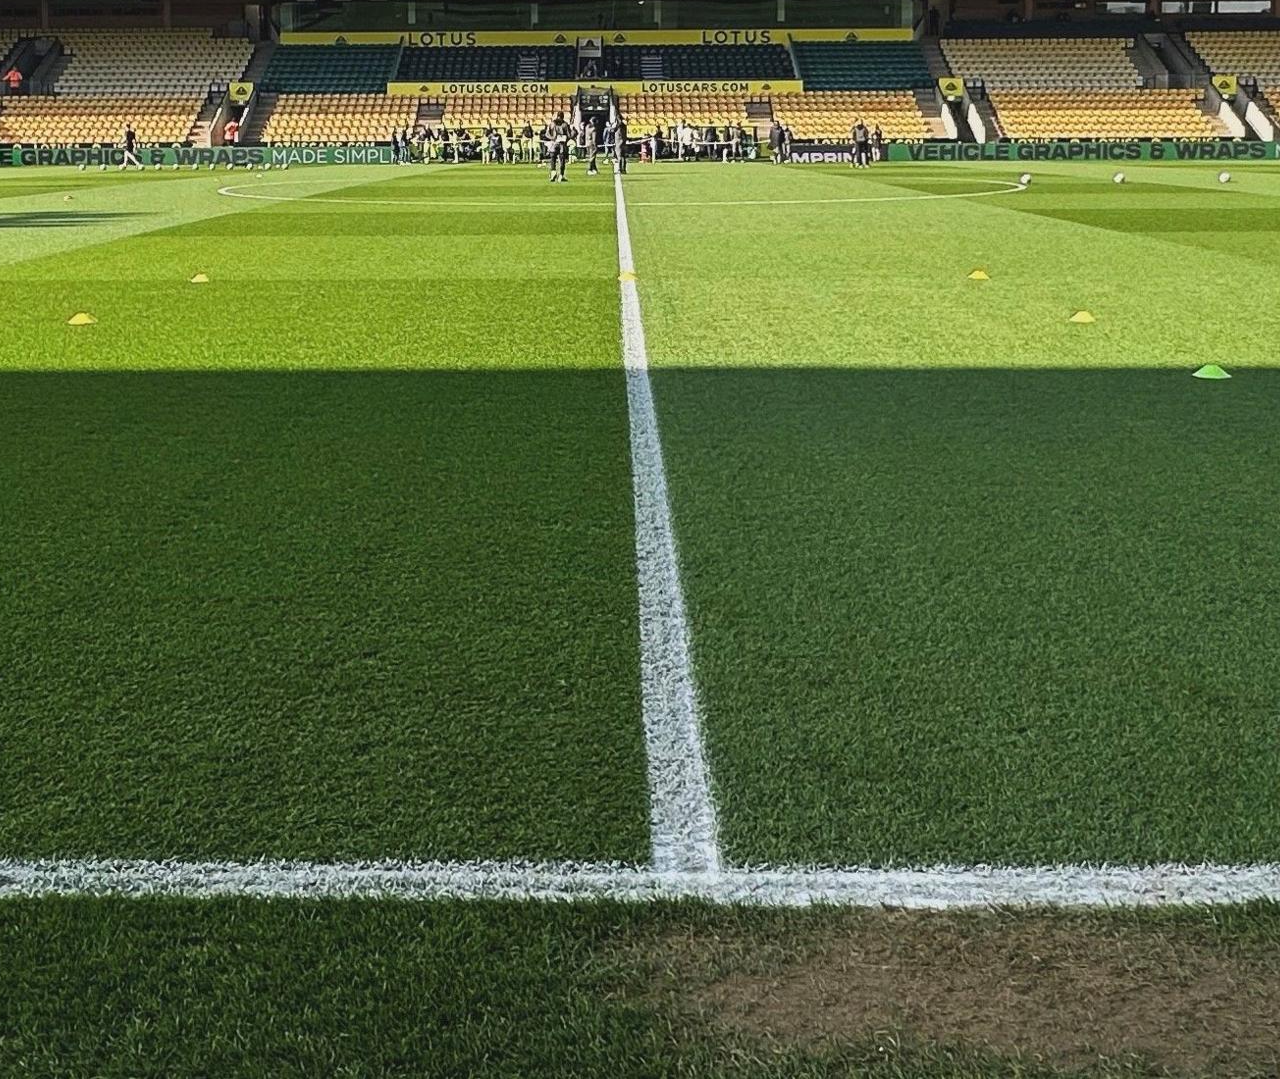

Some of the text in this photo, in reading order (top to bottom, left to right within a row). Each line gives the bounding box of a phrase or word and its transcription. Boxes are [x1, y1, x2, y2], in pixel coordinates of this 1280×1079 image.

[408, 32, 477, 46] LOTUS
[702, 31, 771, 45] LOTUS
[441, 83, 549, 94] LOTUSCARS.COM
[641, 82, 749, 93] LOTUSCARS.COM
[150, 148, 166, 166] &
[174, 148, 265, 166] WRAPS
[272, 148, 328, 165] MADE
[334, 148, 394, 165] SIMPL
[908, 143, 1010, 161] VEHICLE
[1017, 142, 1141, 160] GRAPHICS
[1150, 142, 1164, 159] &
[1175, 142, 1267, 159] WRAPS
